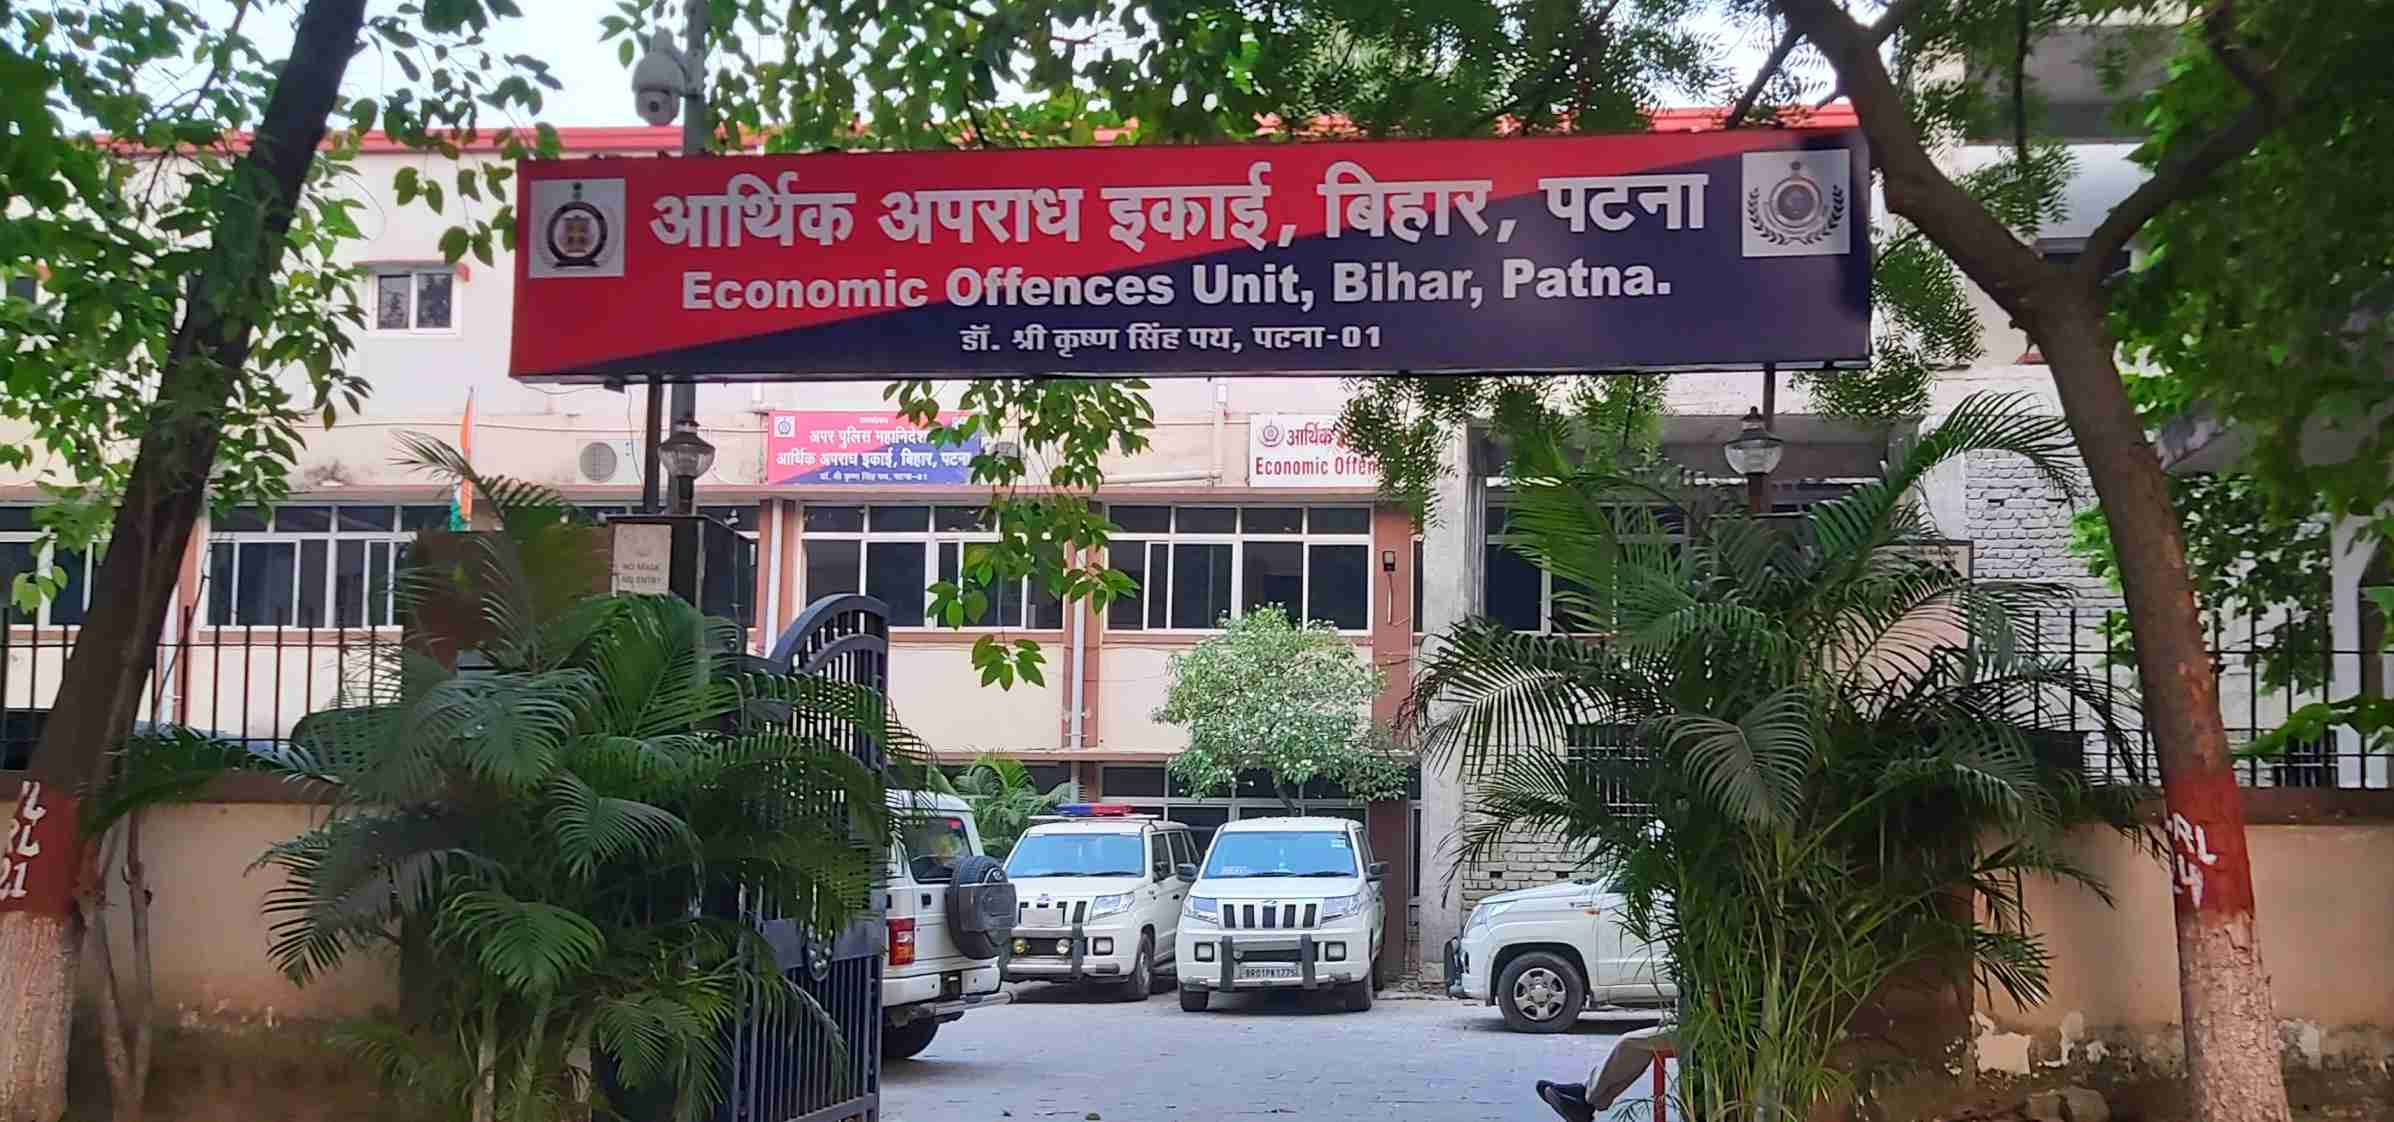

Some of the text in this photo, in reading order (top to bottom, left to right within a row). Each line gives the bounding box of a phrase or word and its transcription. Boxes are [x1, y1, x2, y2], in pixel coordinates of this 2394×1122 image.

[651, 161, 1709, 253] आर्थिक अपराध इकाई, बिहार, पटना
[683, 258, 1671, 312] Economic Offences Unit, Bihar, Patna.
[960, 322, 1380, 358] डॉ. श्री कृष्ण सिंह पथ, पटना-01
[809, 425, 934, 448] अपर पुलिस महानिदेश
[1286, 421, 1334, 447] आर्थिक
[775, 447, 971, 469] आर्थिक अपराध इकाई, बिहार, पटना
[1255, 456, 1329, 476] Economic
